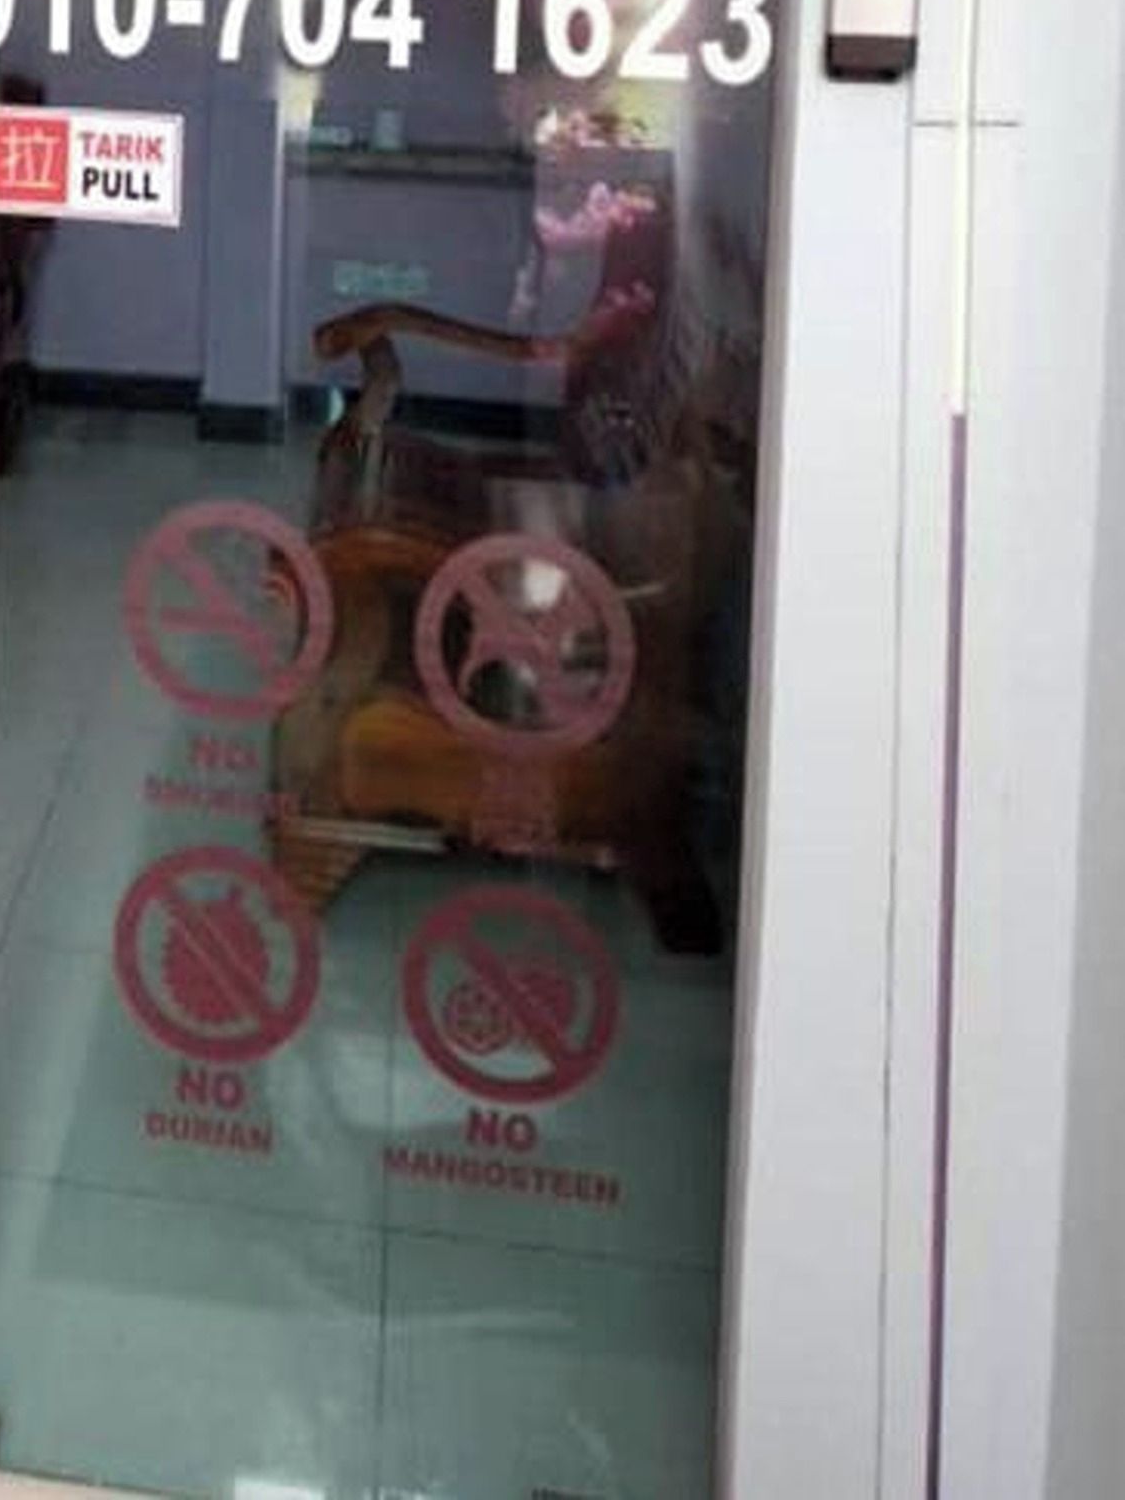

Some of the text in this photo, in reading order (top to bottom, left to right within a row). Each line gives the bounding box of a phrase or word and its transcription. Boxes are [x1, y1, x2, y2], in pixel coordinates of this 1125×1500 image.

[80, 131, 164, 164] TARIK
[81, 166, 160, 201] PULL
[175, 1064, 245, 1111] NO
[145, 1112, 275, 1154] DURIAN
[464, 1107, 539, 1153] NO
[382, 1145, 624, 1206] MANGOSTEEN
